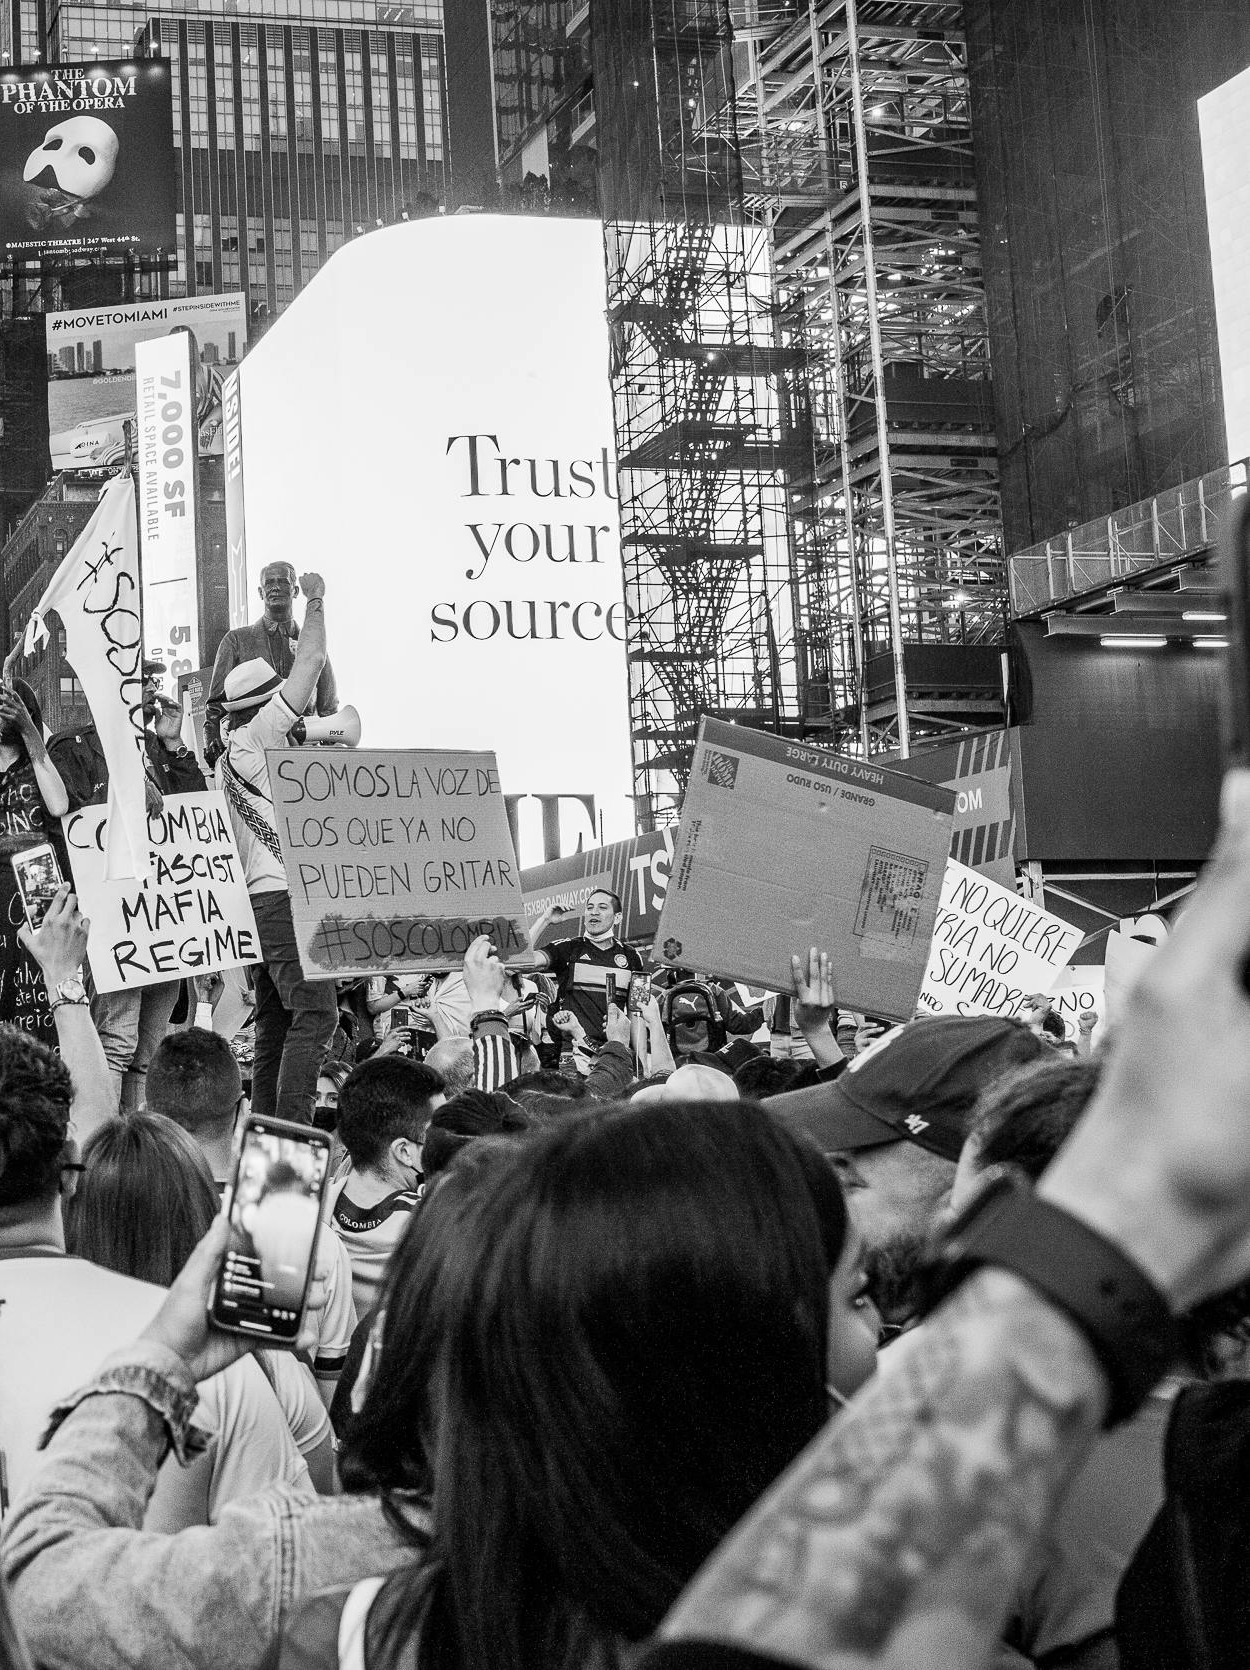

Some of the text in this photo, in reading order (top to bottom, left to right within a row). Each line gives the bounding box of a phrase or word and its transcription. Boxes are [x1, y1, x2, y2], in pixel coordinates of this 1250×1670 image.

[1, 76, 138, 103] PHANTOM
[51, 69, 84, 81] THE
[14, 97, 126, 114] OF THE OPERA
[48, 238, 82, 247] THEATRE
[87, 237, 100, 245] 247
[101, 236, 116, 244] West
[51, 308, 168, 331] #MOVETOMIAMI
[172, 299, 241, 313] #STEPINSIDEWITHME
[143, 376, 159, 542] RETAIL SPACE AVAILABLE
[158, 370, 186, 518] 7,000 SF
[446, 434, 619, 500] Trust
[464, 522, 610, 580] your
[277, 759, 501, 803] SOMOS LA VOZ DE
[785, 746, 884, 785] HEAVY DUTY LARGE
[786, 773, 811, 789] RUDO
[813, 782, 832, 795] USO
[840, 791, 876, 807] GRANDE
[285, 816, 476, 848] LOS QUE YA NO
[299, 859, 515, 905] PUEDEN GRITAR
[122, 888, 225, 934] MAFIA
[950, 877, 989, 914] NO
[983, 896, 1076, 967] QUIERE
[111, 925, 258, 983] REGIME
[316, 919, 520, 964] #SOSCOLOMBIA
[979, 942, 1019, 975] NO
[930, 948, 960, 986] SU
[339, 1213, 382, 1229] COLOMBIA
